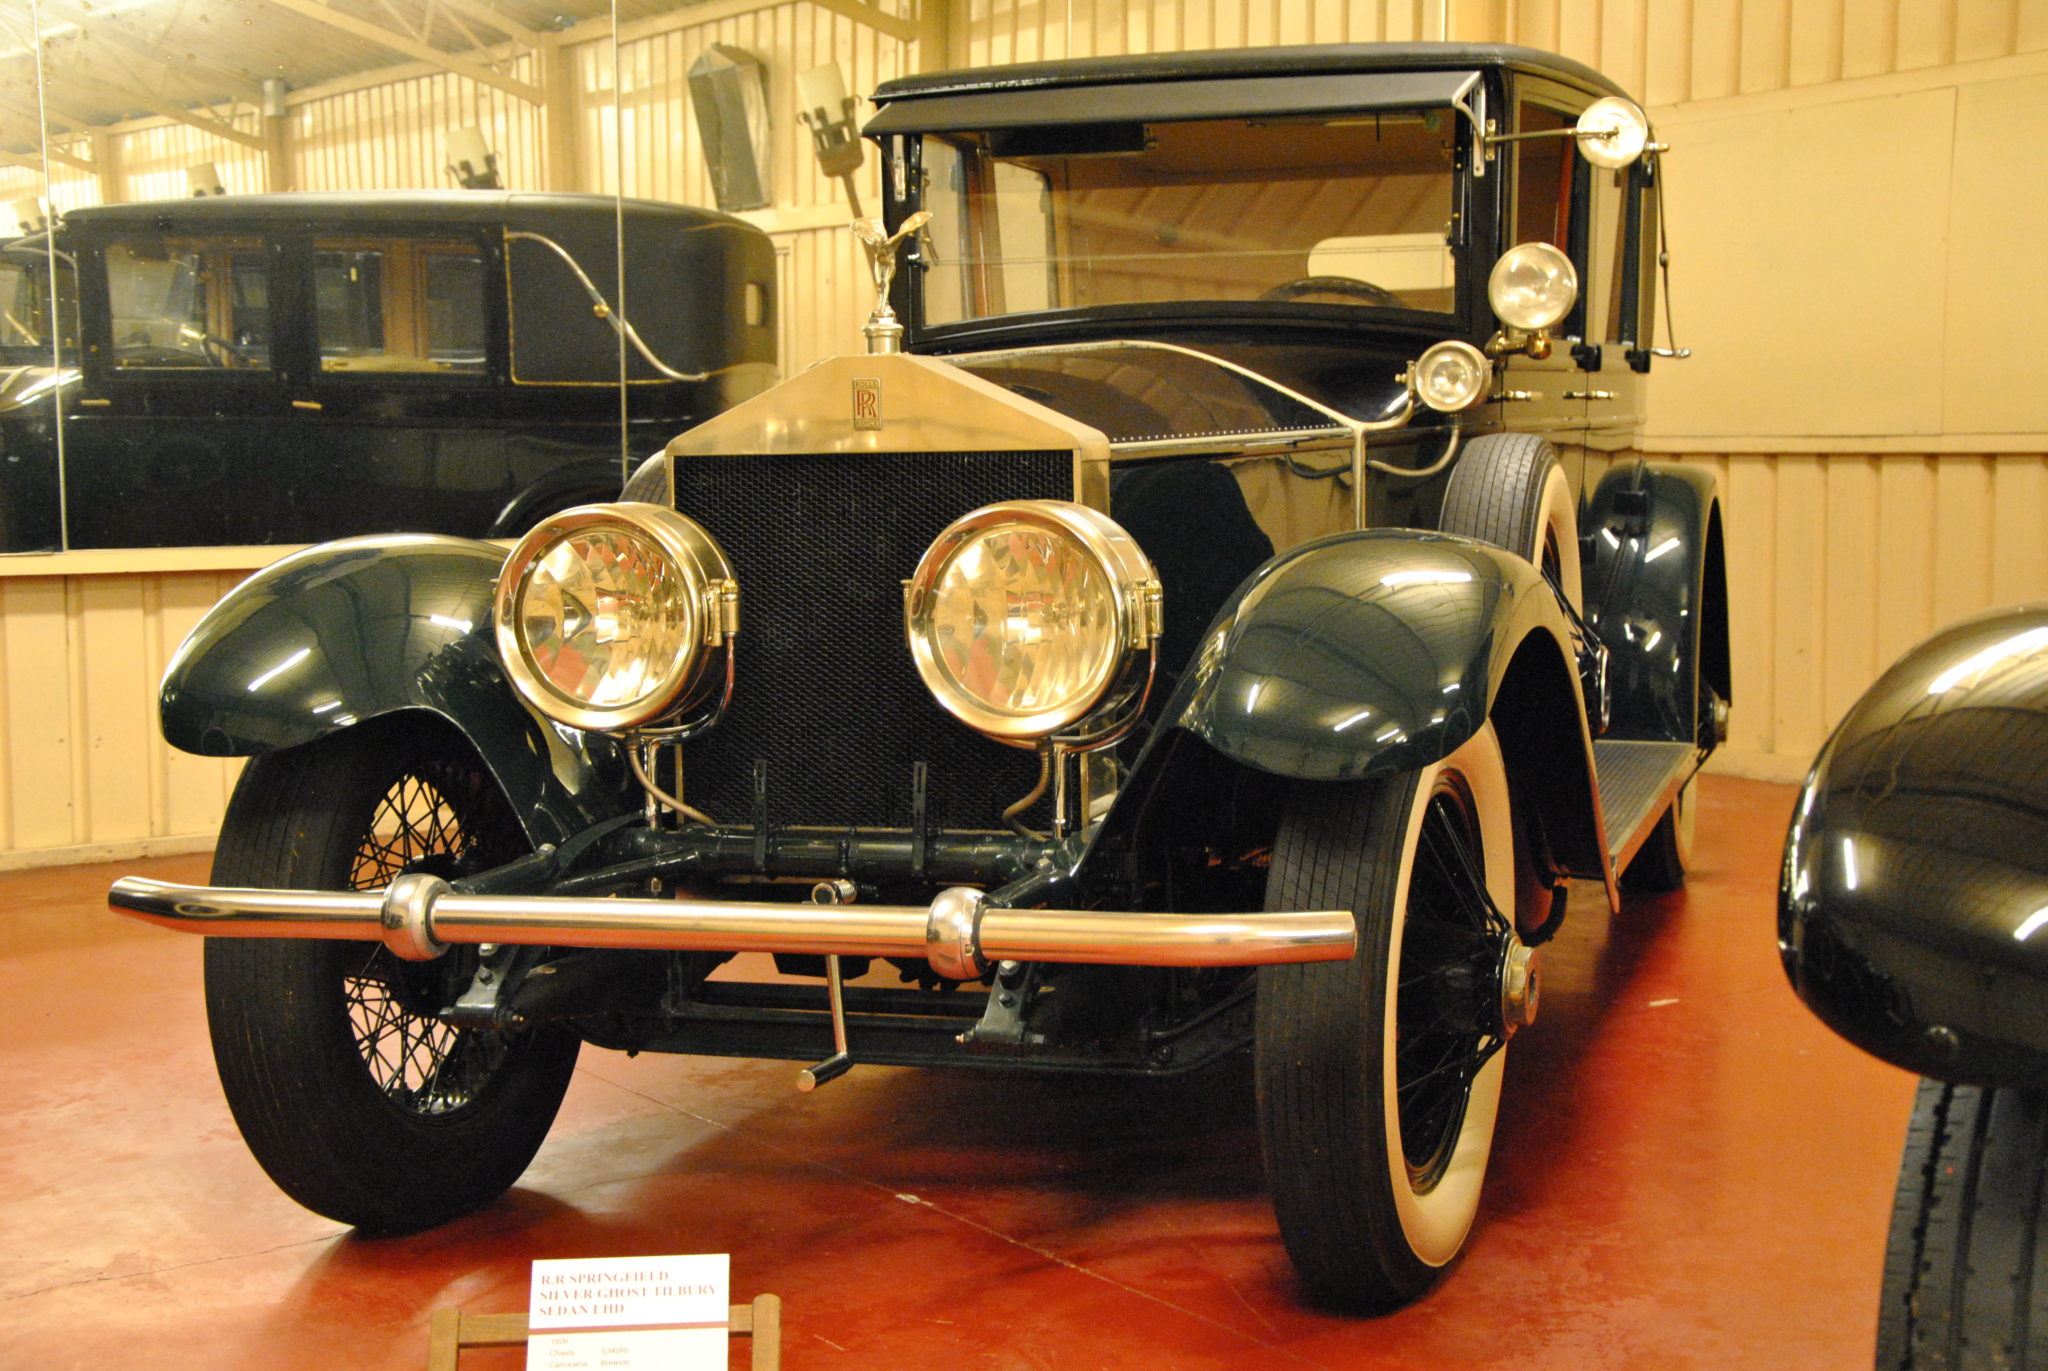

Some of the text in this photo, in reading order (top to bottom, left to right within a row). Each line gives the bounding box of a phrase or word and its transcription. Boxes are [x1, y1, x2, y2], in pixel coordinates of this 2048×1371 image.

[569, 1270, 669, 1285] SPRINGFIELD
[539, 1284, 716, 1301] SILVER GHOST TILBURY
[538, 1303, 625, 1317] SEDAN LHD
